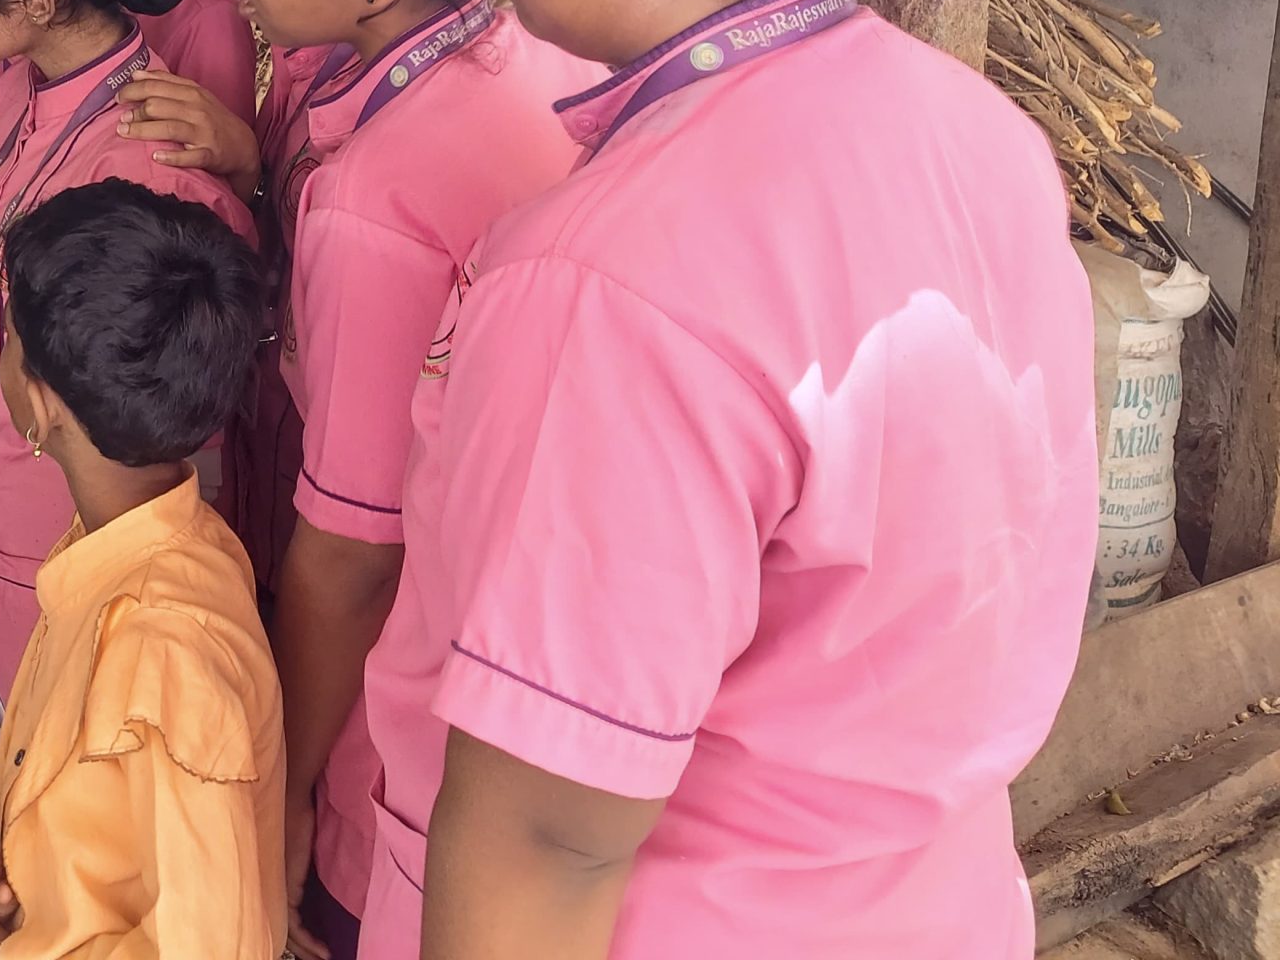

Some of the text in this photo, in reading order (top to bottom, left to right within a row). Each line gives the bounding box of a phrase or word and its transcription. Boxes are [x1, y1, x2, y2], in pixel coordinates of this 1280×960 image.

[1109, 423, 1162, 459] Mills
[1107, 468, 1163, 491] Industrial
[1117, 537, 1140, 559] 34
[1105, 568, 1148, 588] Sale
